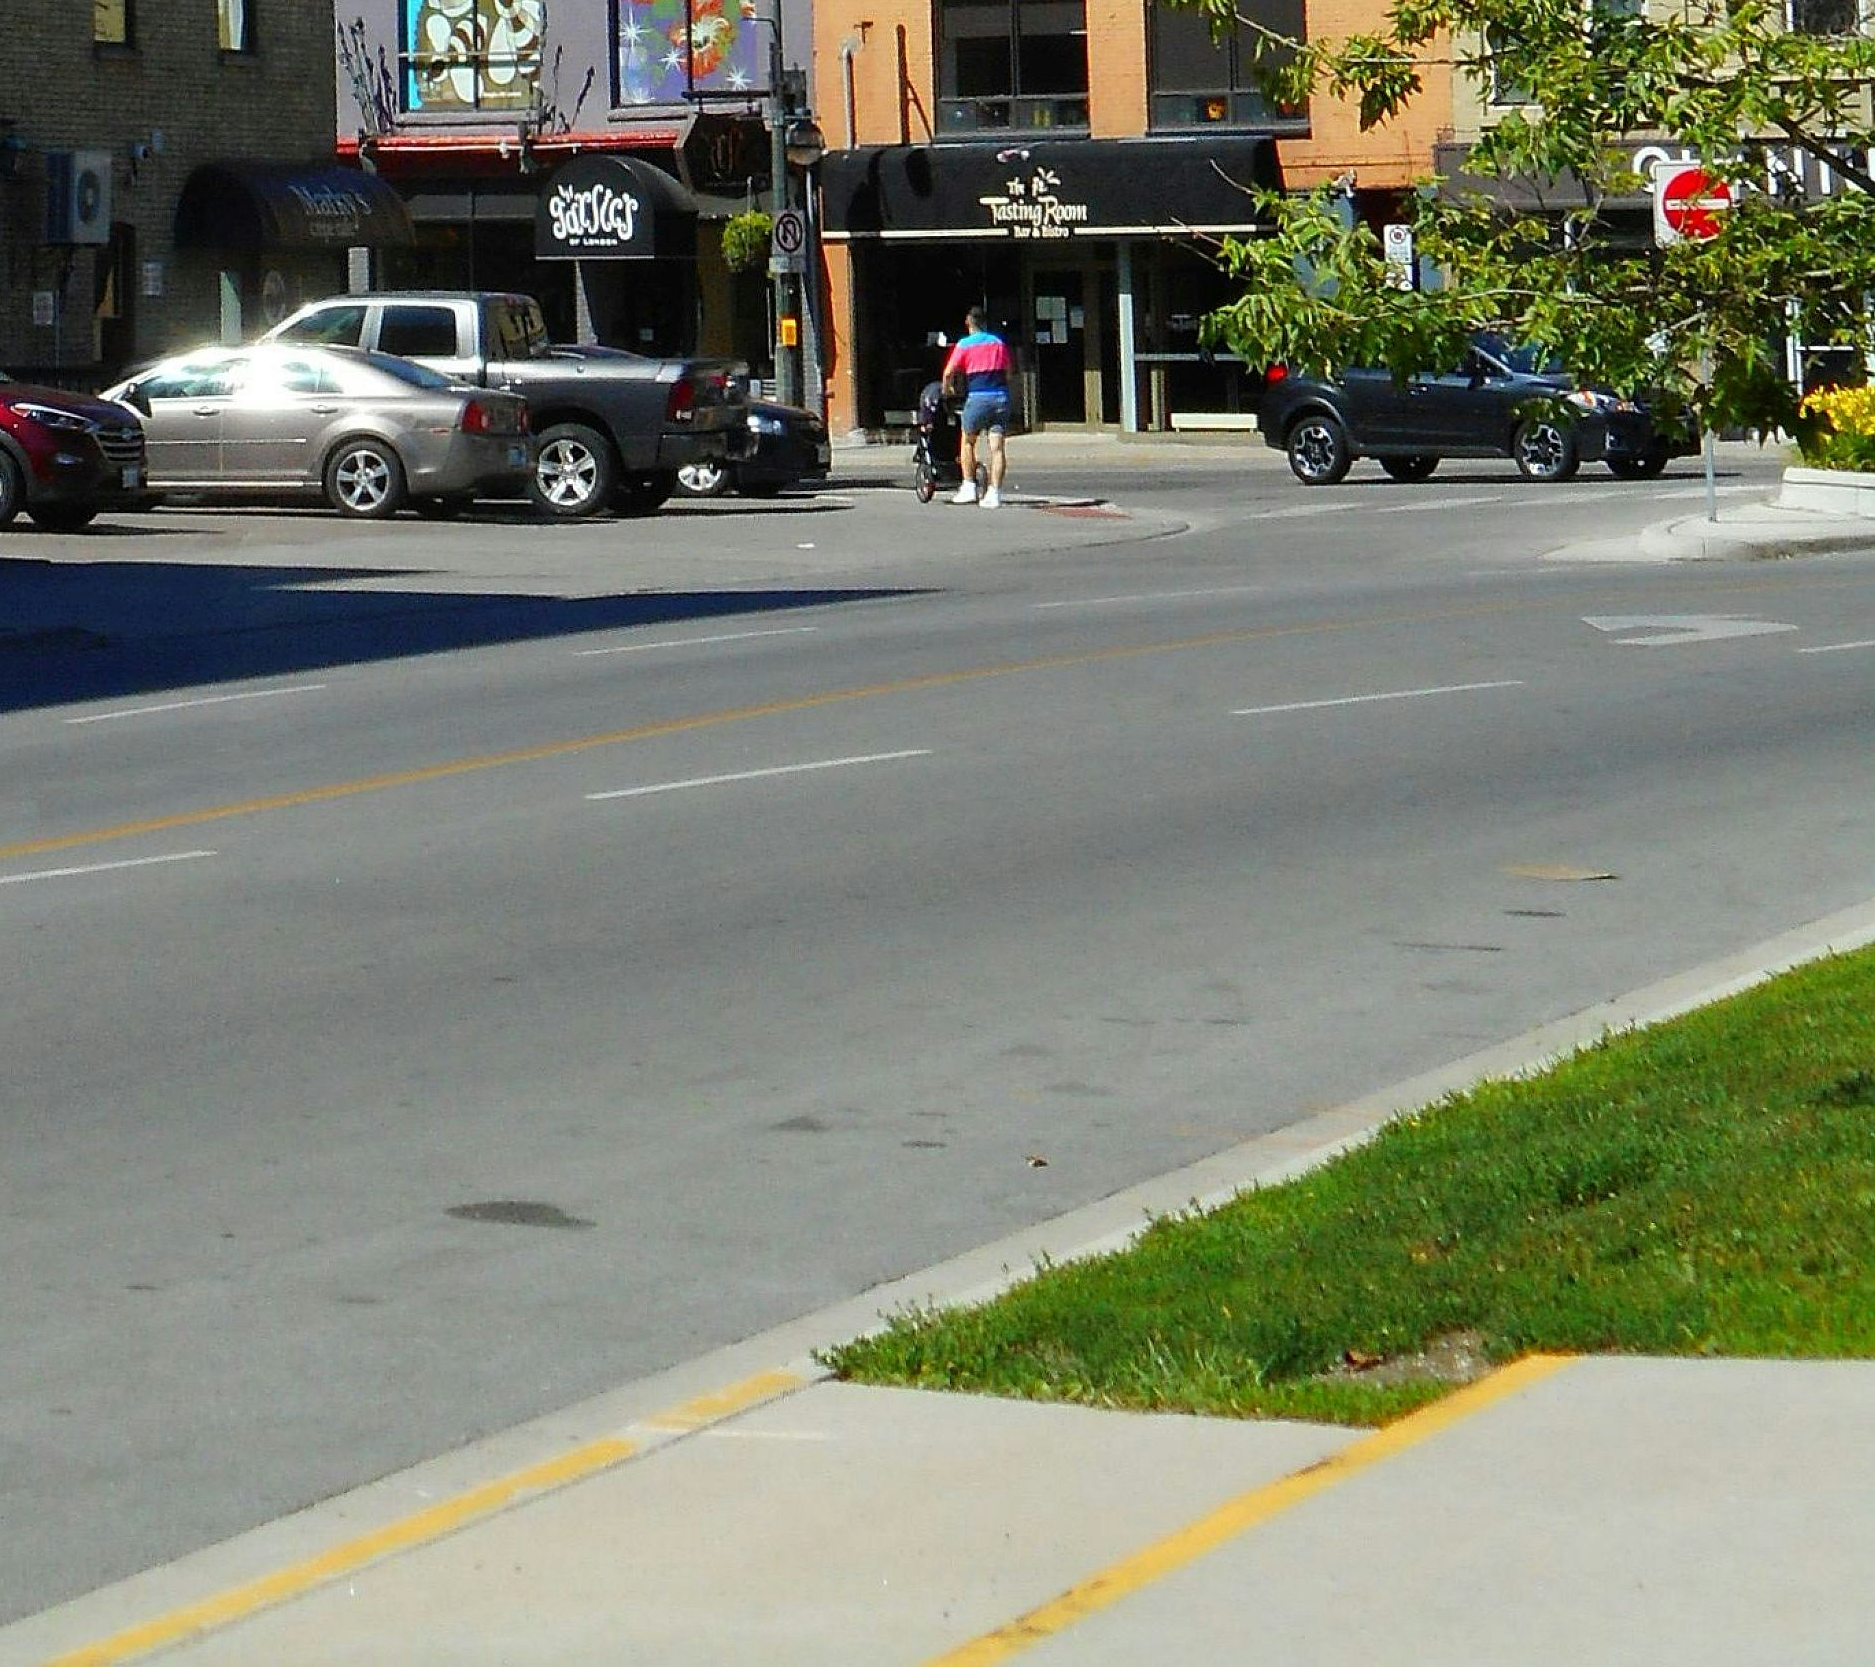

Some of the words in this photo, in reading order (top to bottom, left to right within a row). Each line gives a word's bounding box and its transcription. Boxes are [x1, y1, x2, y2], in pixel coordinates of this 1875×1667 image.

[979, 196, 1043, 226] Tasting
[1037, 195, 1088, 225] Room
[1013, 225, 1031, 238] Bar
